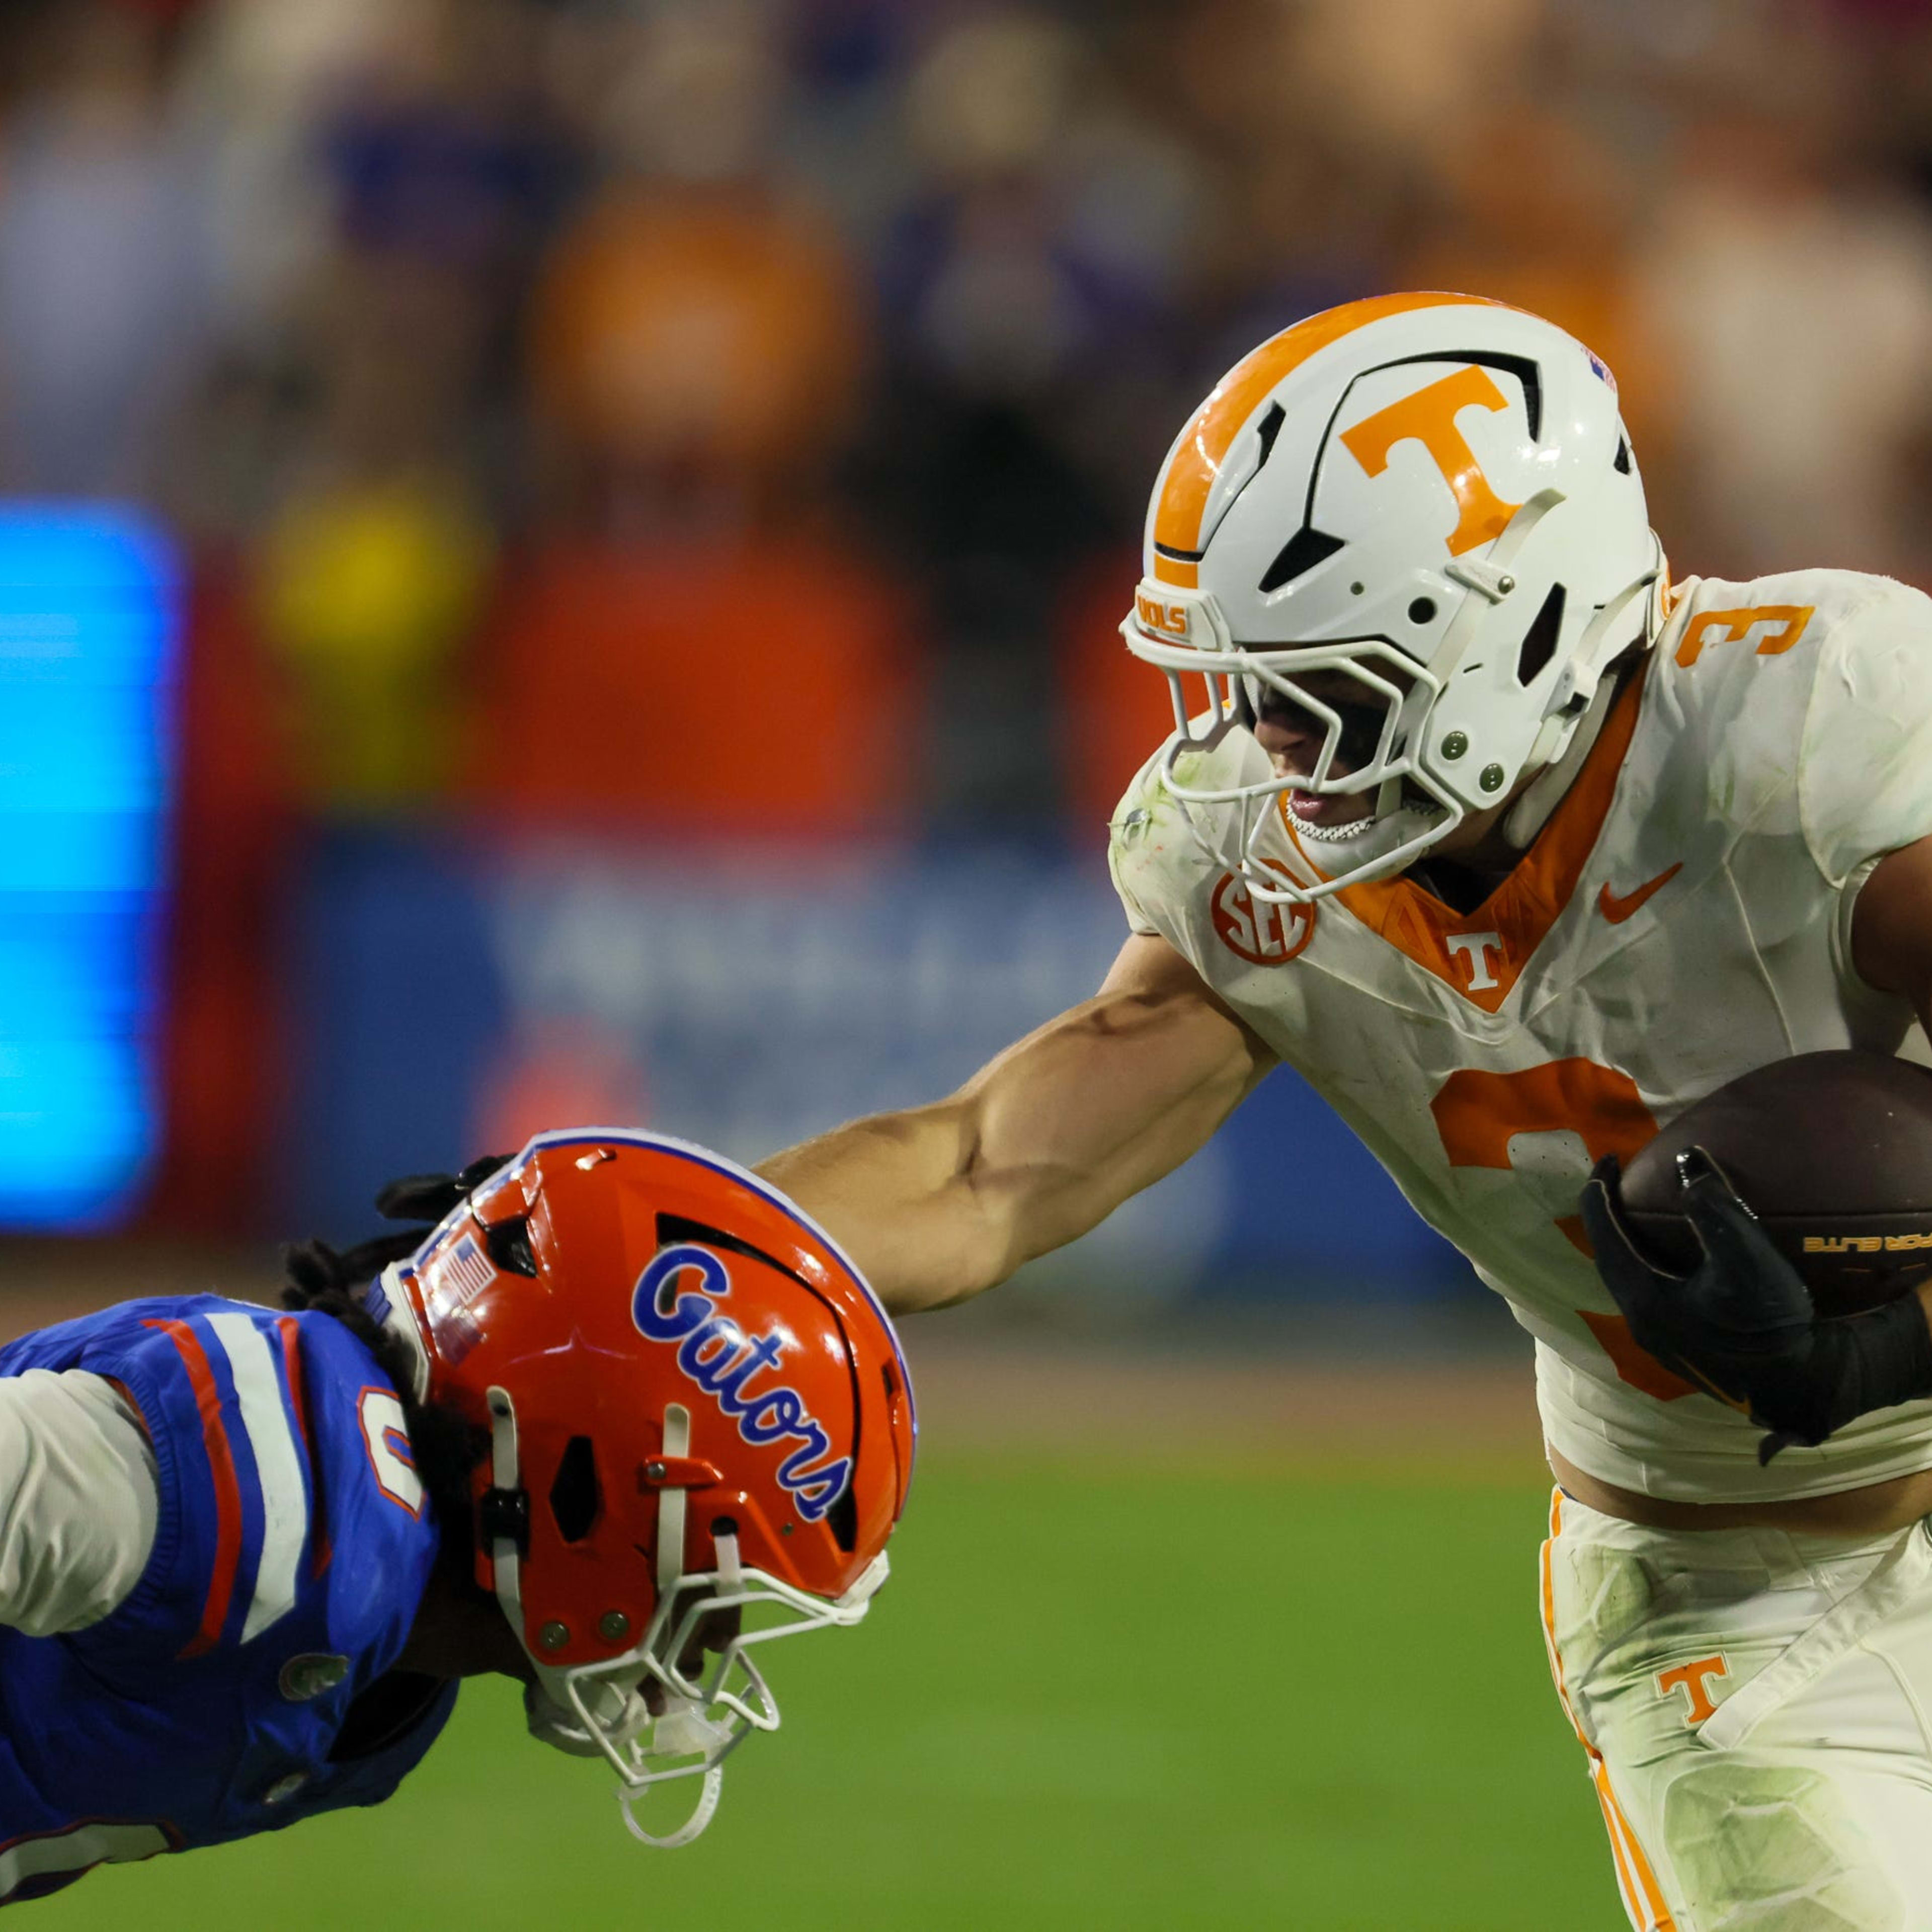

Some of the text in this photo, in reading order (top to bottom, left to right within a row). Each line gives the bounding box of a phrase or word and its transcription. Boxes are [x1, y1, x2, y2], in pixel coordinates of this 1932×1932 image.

[1339, 364, 1524, 557] T
[1674, 605, 1815, 669] 3
[1218, 866, 1307, 956] SEC
[1446, 932, 1502, 991] T
[1803, 1236, 1883, 1253] ELITE
[631, 1244, 852, 1522] Gators
[1657, 1655, 1727, 1725] T
